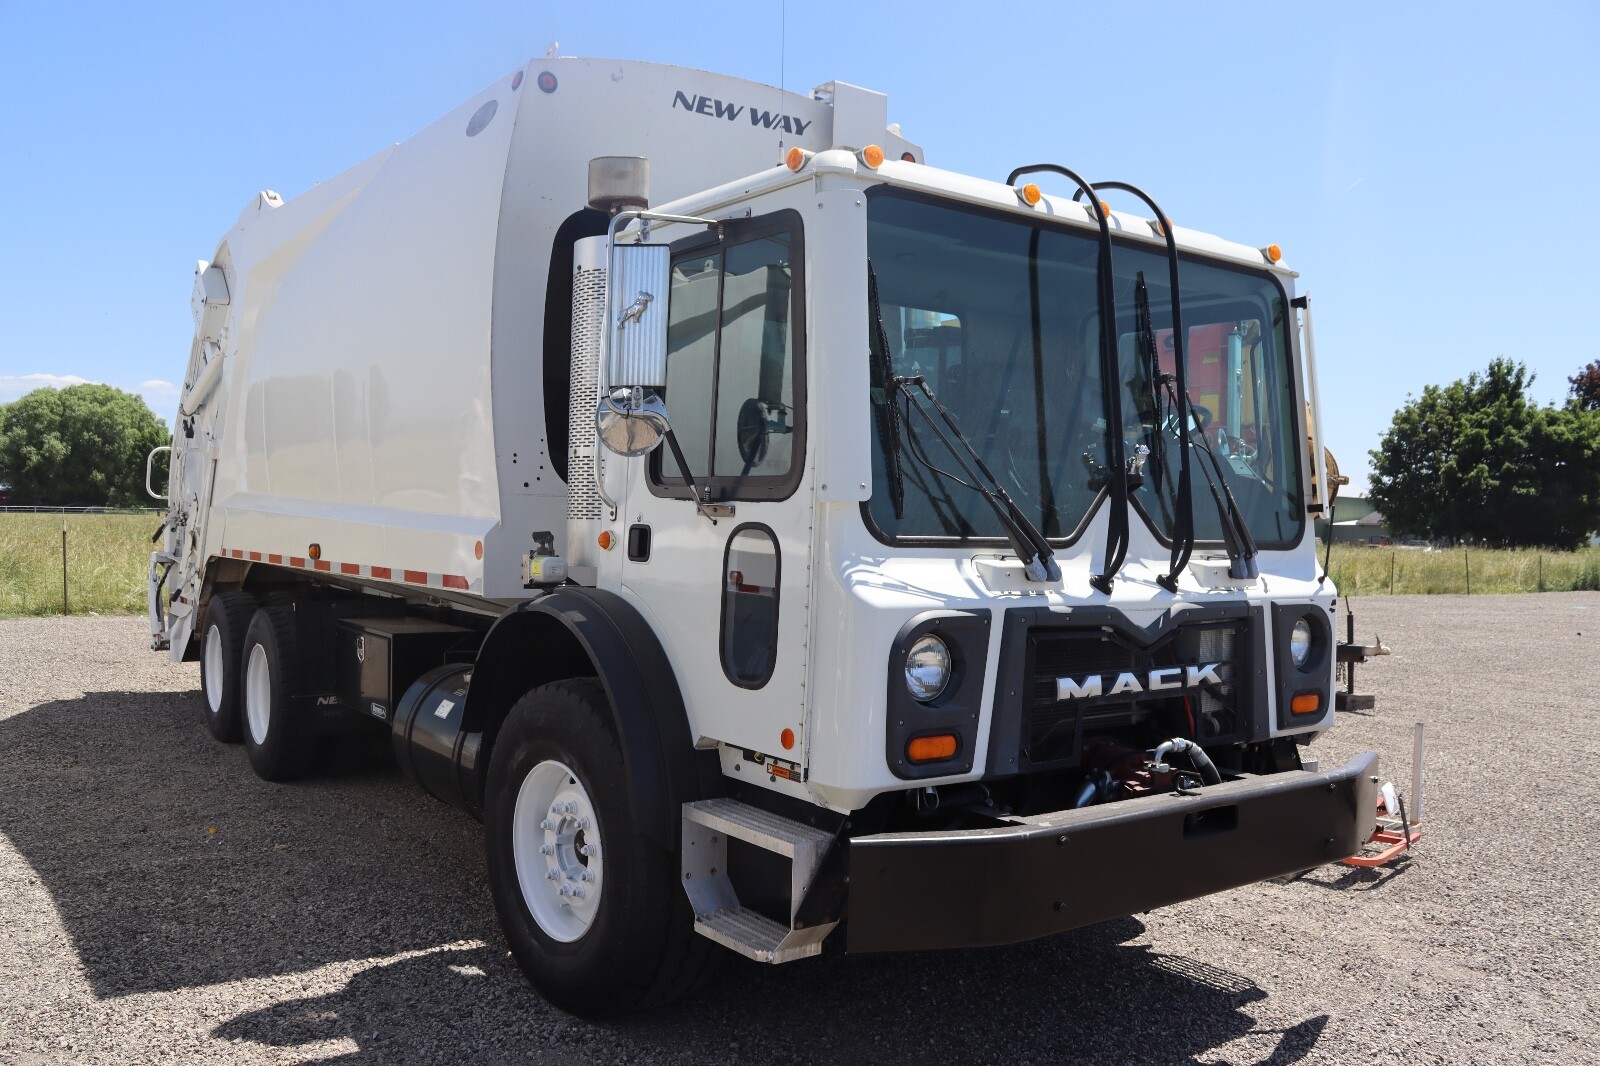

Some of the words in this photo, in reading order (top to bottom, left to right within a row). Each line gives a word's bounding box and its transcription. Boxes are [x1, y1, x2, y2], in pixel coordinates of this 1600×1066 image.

[672, 90, 744, 121] NEW
[750, 107, 812, 136] WAY
[1056, 662, 1222, 701] MACK
